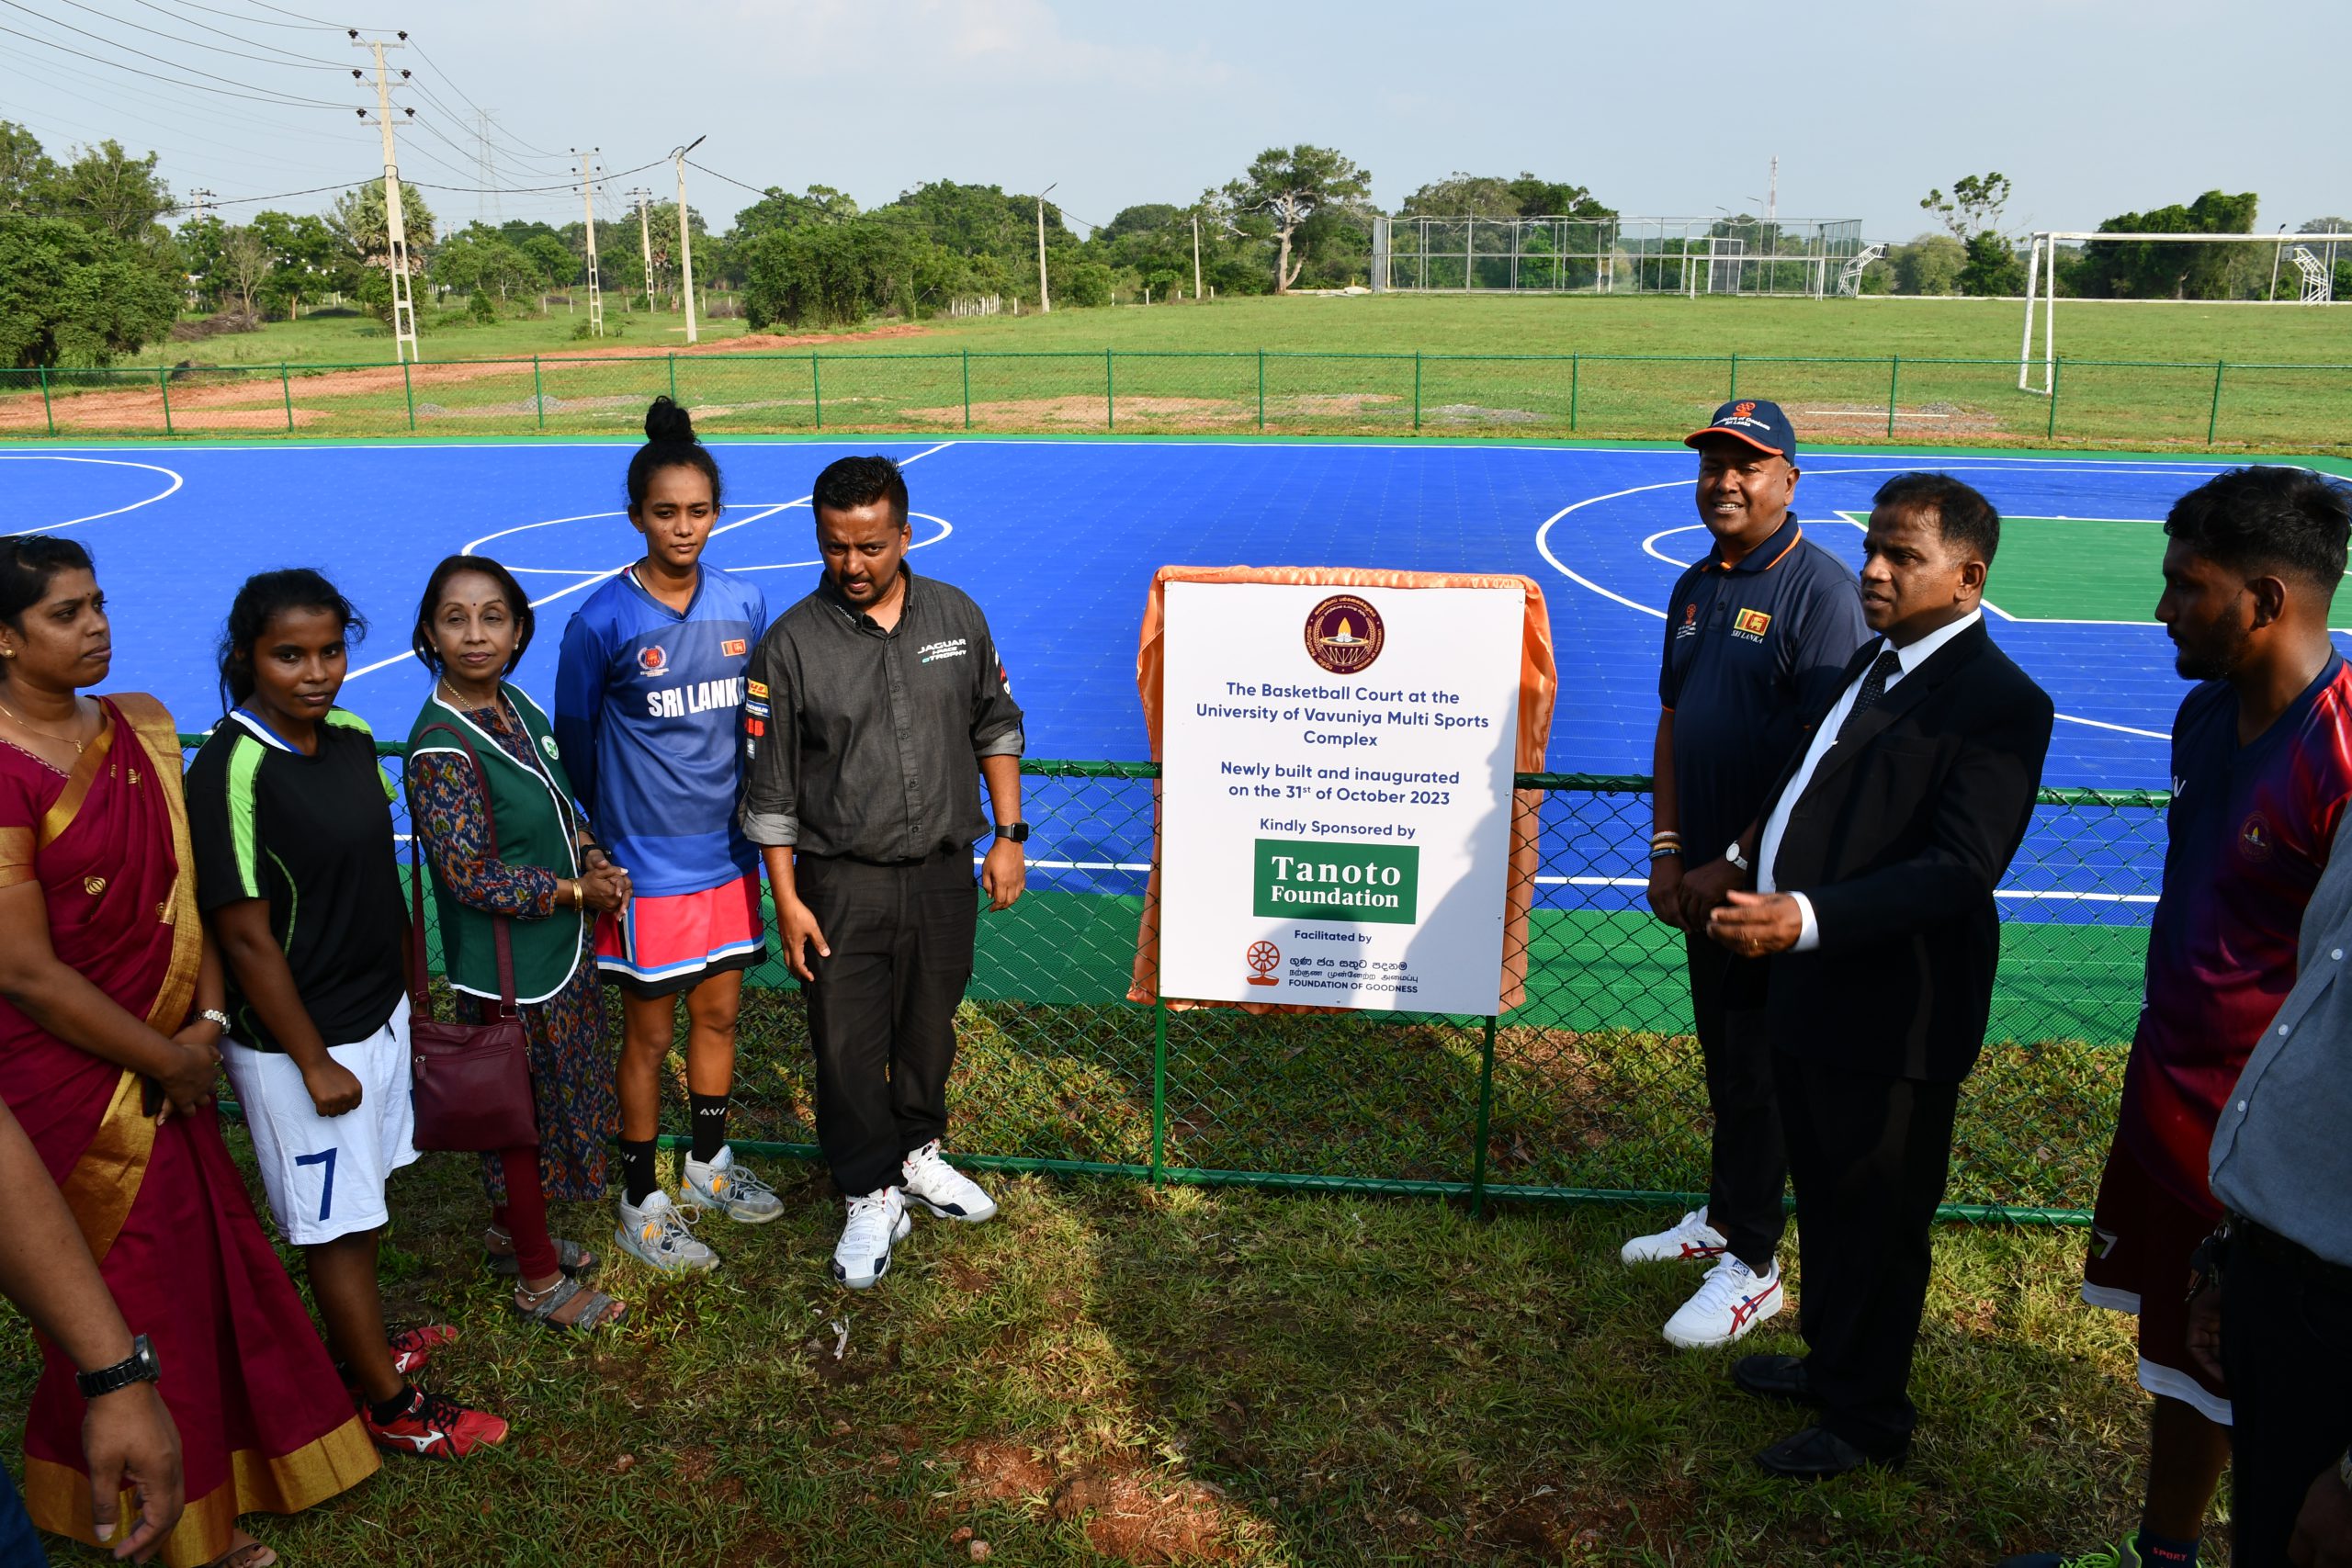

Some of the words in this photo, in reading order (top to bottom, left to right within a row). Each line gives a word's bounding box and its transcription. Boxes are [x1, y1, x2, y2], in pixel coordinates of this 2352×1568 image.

[917, 638, 967, 654] JAGUAR
[1731, 629, 1742, 638] SRI
[1740, 631, 1764, 644] LANKA
[647, 687, 684, 717] SRI
[1226, 682, 1257, 696] The
[1261, 683, 1351, 700] Basketball
[1355, 687, 1404, 702] Court
[1408, 691, 1427, 703] at
[1431, 690, 1460, 705] the
[1196, 703, 1279, 723] University
[1283, 707, 1300, 721] of
[1304, 707, 1382, 727] Vavuniya
[1387, 711, 1429, 726] Multi
[1433, 713, 1489, 730] Sports
[1304, 730, 1378, 749] Complex
[1220, 761, 1271, 780] Newly
[1275, 763, 1313, 778] built
[1317, 766, 1350, 780] and
[1355, 767, 1460, 785] inaugurated
[1228, 785, 1250, 796] on
[1254, 784, 1282, 798] the
[1285, 784, 1311, 799] 31st
[1316, 787, 1333, 800] of
[1336, 787, 1406, 804] October
[1409, 790, 1450, 805] 2023
[1260, 818, 1307, 835] Kindly
[1311, 820, 1393, 836] Sponsored
[1397, 824, 1416, 840] by
[1271, 855, 1401, 886] Tanoto
[1271, 885, 1399, 908] Foundation
[1294, 930, 1355, 942] Facilitated
[1358, 933, 1373, 944] by
[1288, 978, 1349, 989] FOUNDATION
[1351, 982, 1363, 990] OF
[1365, 983, 1419, 993] GOODNESS
[295, 1147, 337, 1222] 7
[2153, 1547, 2188, 1562] SPORT
